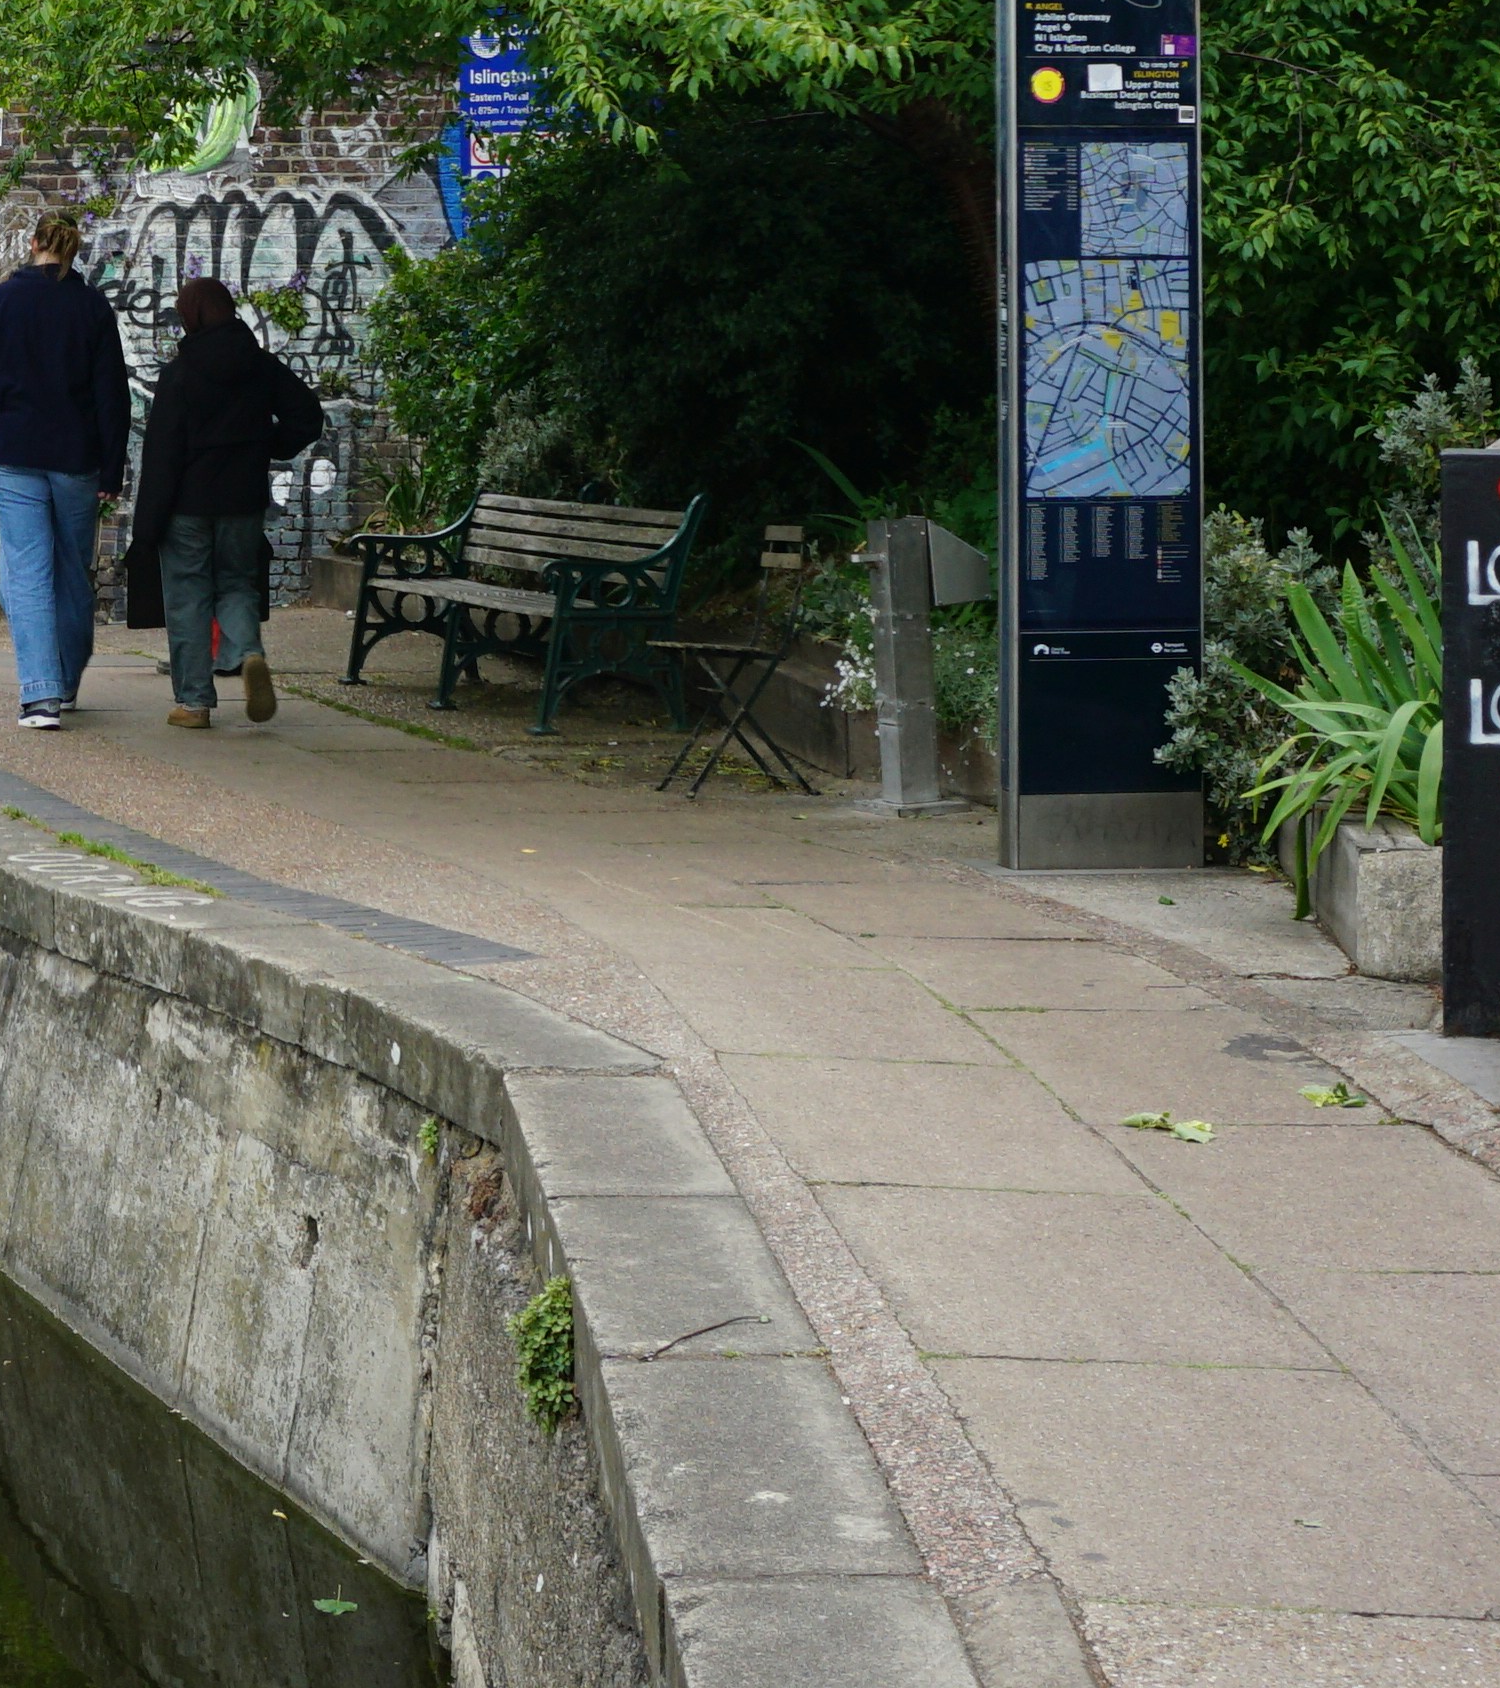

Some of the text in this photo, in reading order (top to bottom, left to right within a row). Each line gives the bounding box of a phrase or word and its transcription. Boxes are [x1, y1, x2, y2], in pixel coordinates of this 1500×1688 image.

[1034, 13, 1111, 23] Jubilee Greenway
[1034, 24, 1060, 33] Angel
[1050, 34, 1088, 44] Islington
[1035, 44, 1136, 54] City & Islington College
[1125, 81, 1180, 90] Upper Street
[470, 93, 502, 102] Eastern
[1080, 91, 1180, 101] Business Design Centre
[1114, 101, 1180, 111] Islington Green
